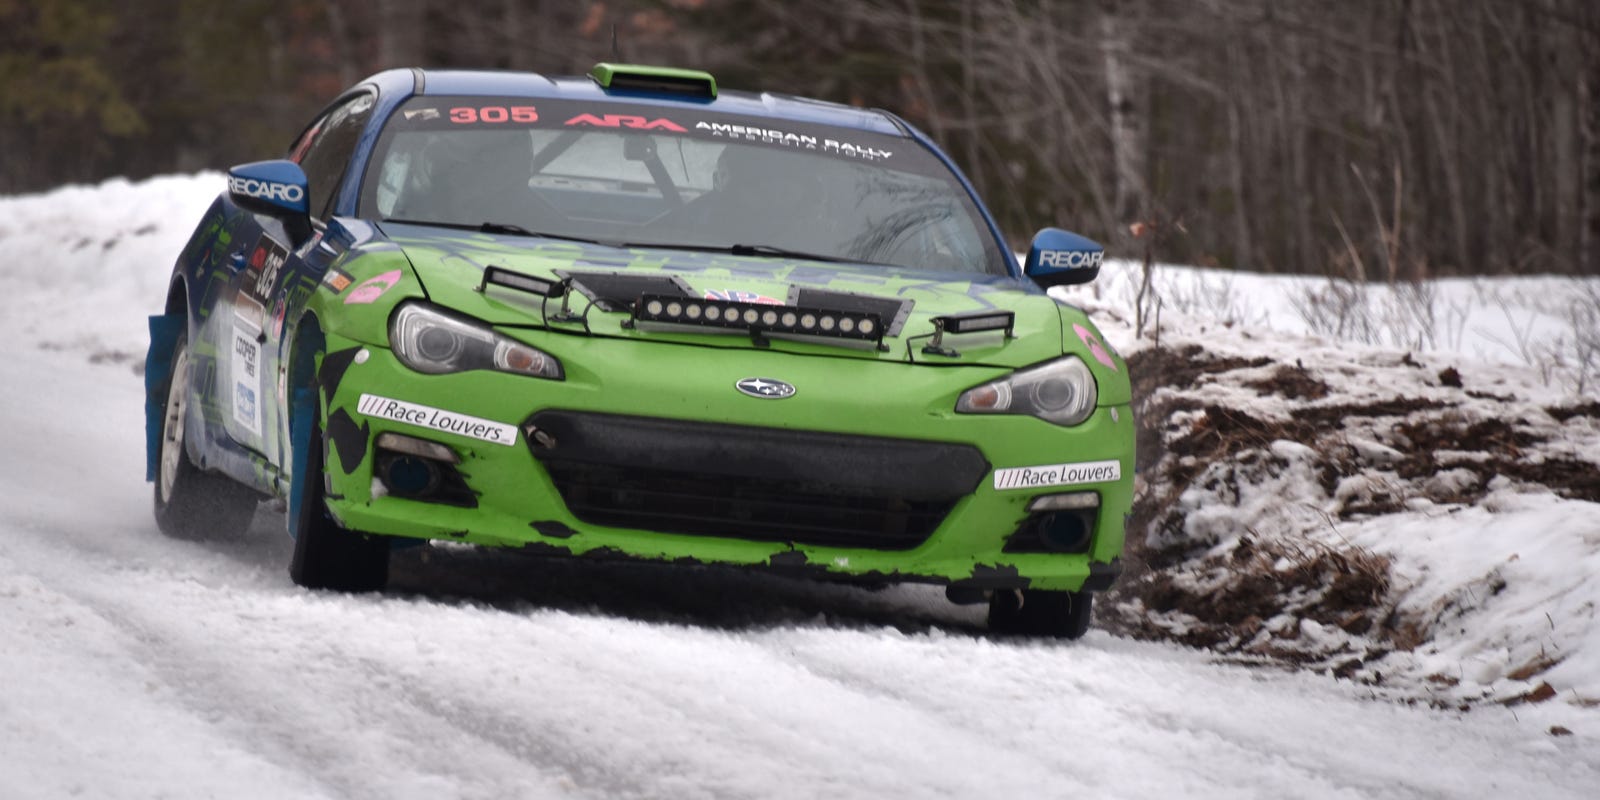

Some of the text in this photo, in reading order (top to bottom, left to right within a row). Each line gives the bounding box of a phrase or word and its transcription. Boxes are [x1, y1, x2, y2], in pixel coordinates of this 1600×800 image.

[449, 106, 539, 124] 305
[563, 112, 689, 133] ARA
[695, 120, 893, 159] AMERICAN RALLY
[228, 176, 304, 203] RECARO
[1038, 249, 1105, 269] RECAR
[256, 252, 284, 300] 305
[235, 335, 256, 364] COOPER
[383, 401, 503, 441] Race Louvers
[1020, 465, 1115, 486] Race Louvers
